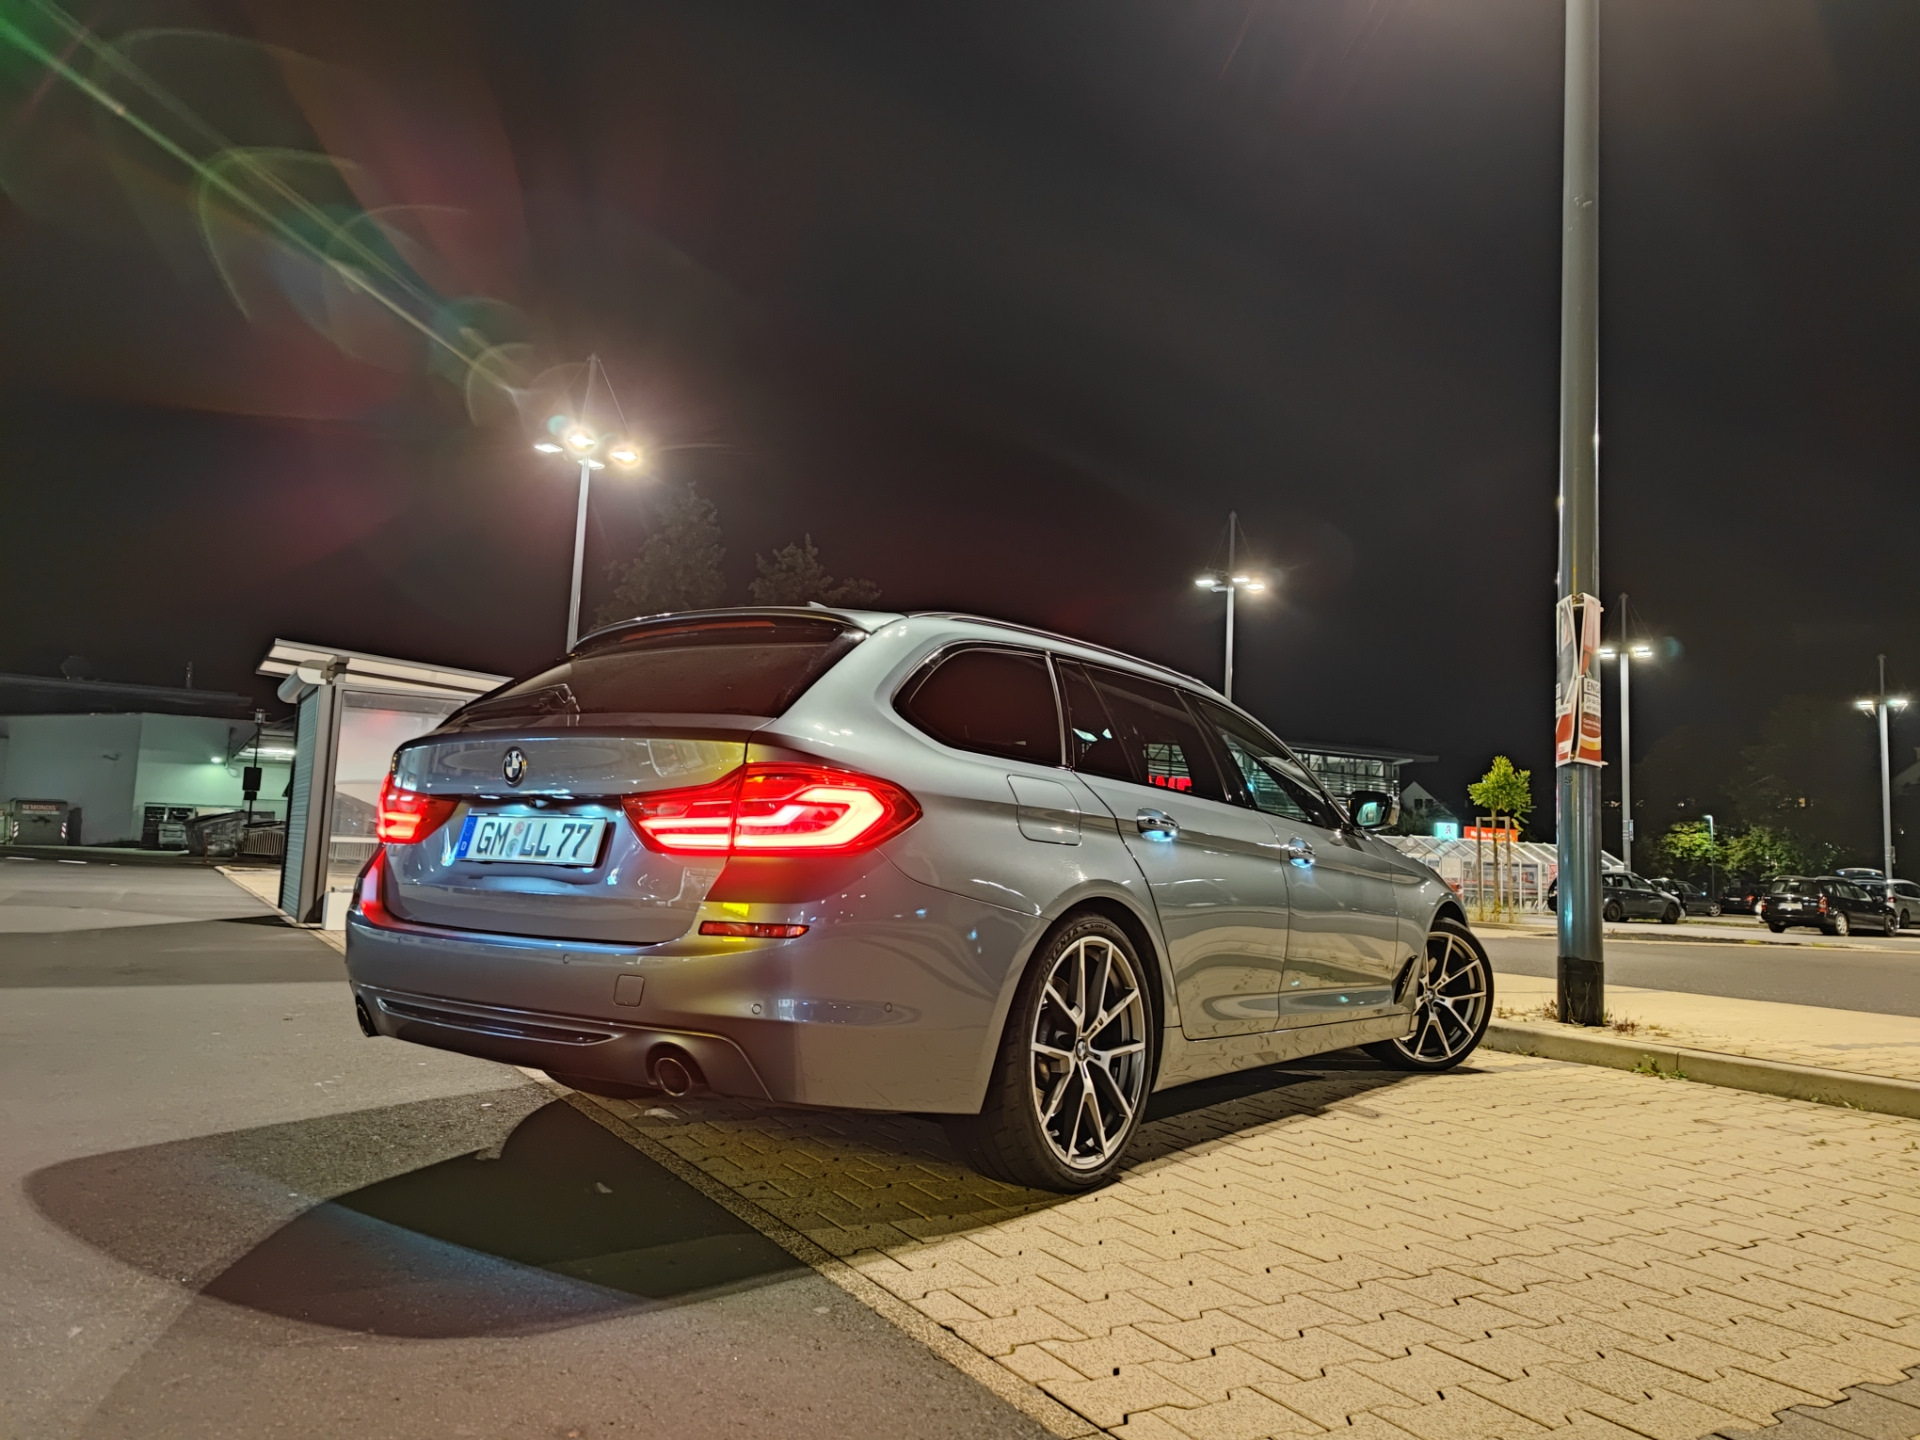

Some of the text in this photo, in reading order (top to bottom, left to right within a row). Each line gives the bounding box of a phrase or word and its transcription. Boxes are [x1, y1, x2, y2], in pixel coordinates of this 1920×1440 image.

[476, 821, 594, 858] GM LL 77
